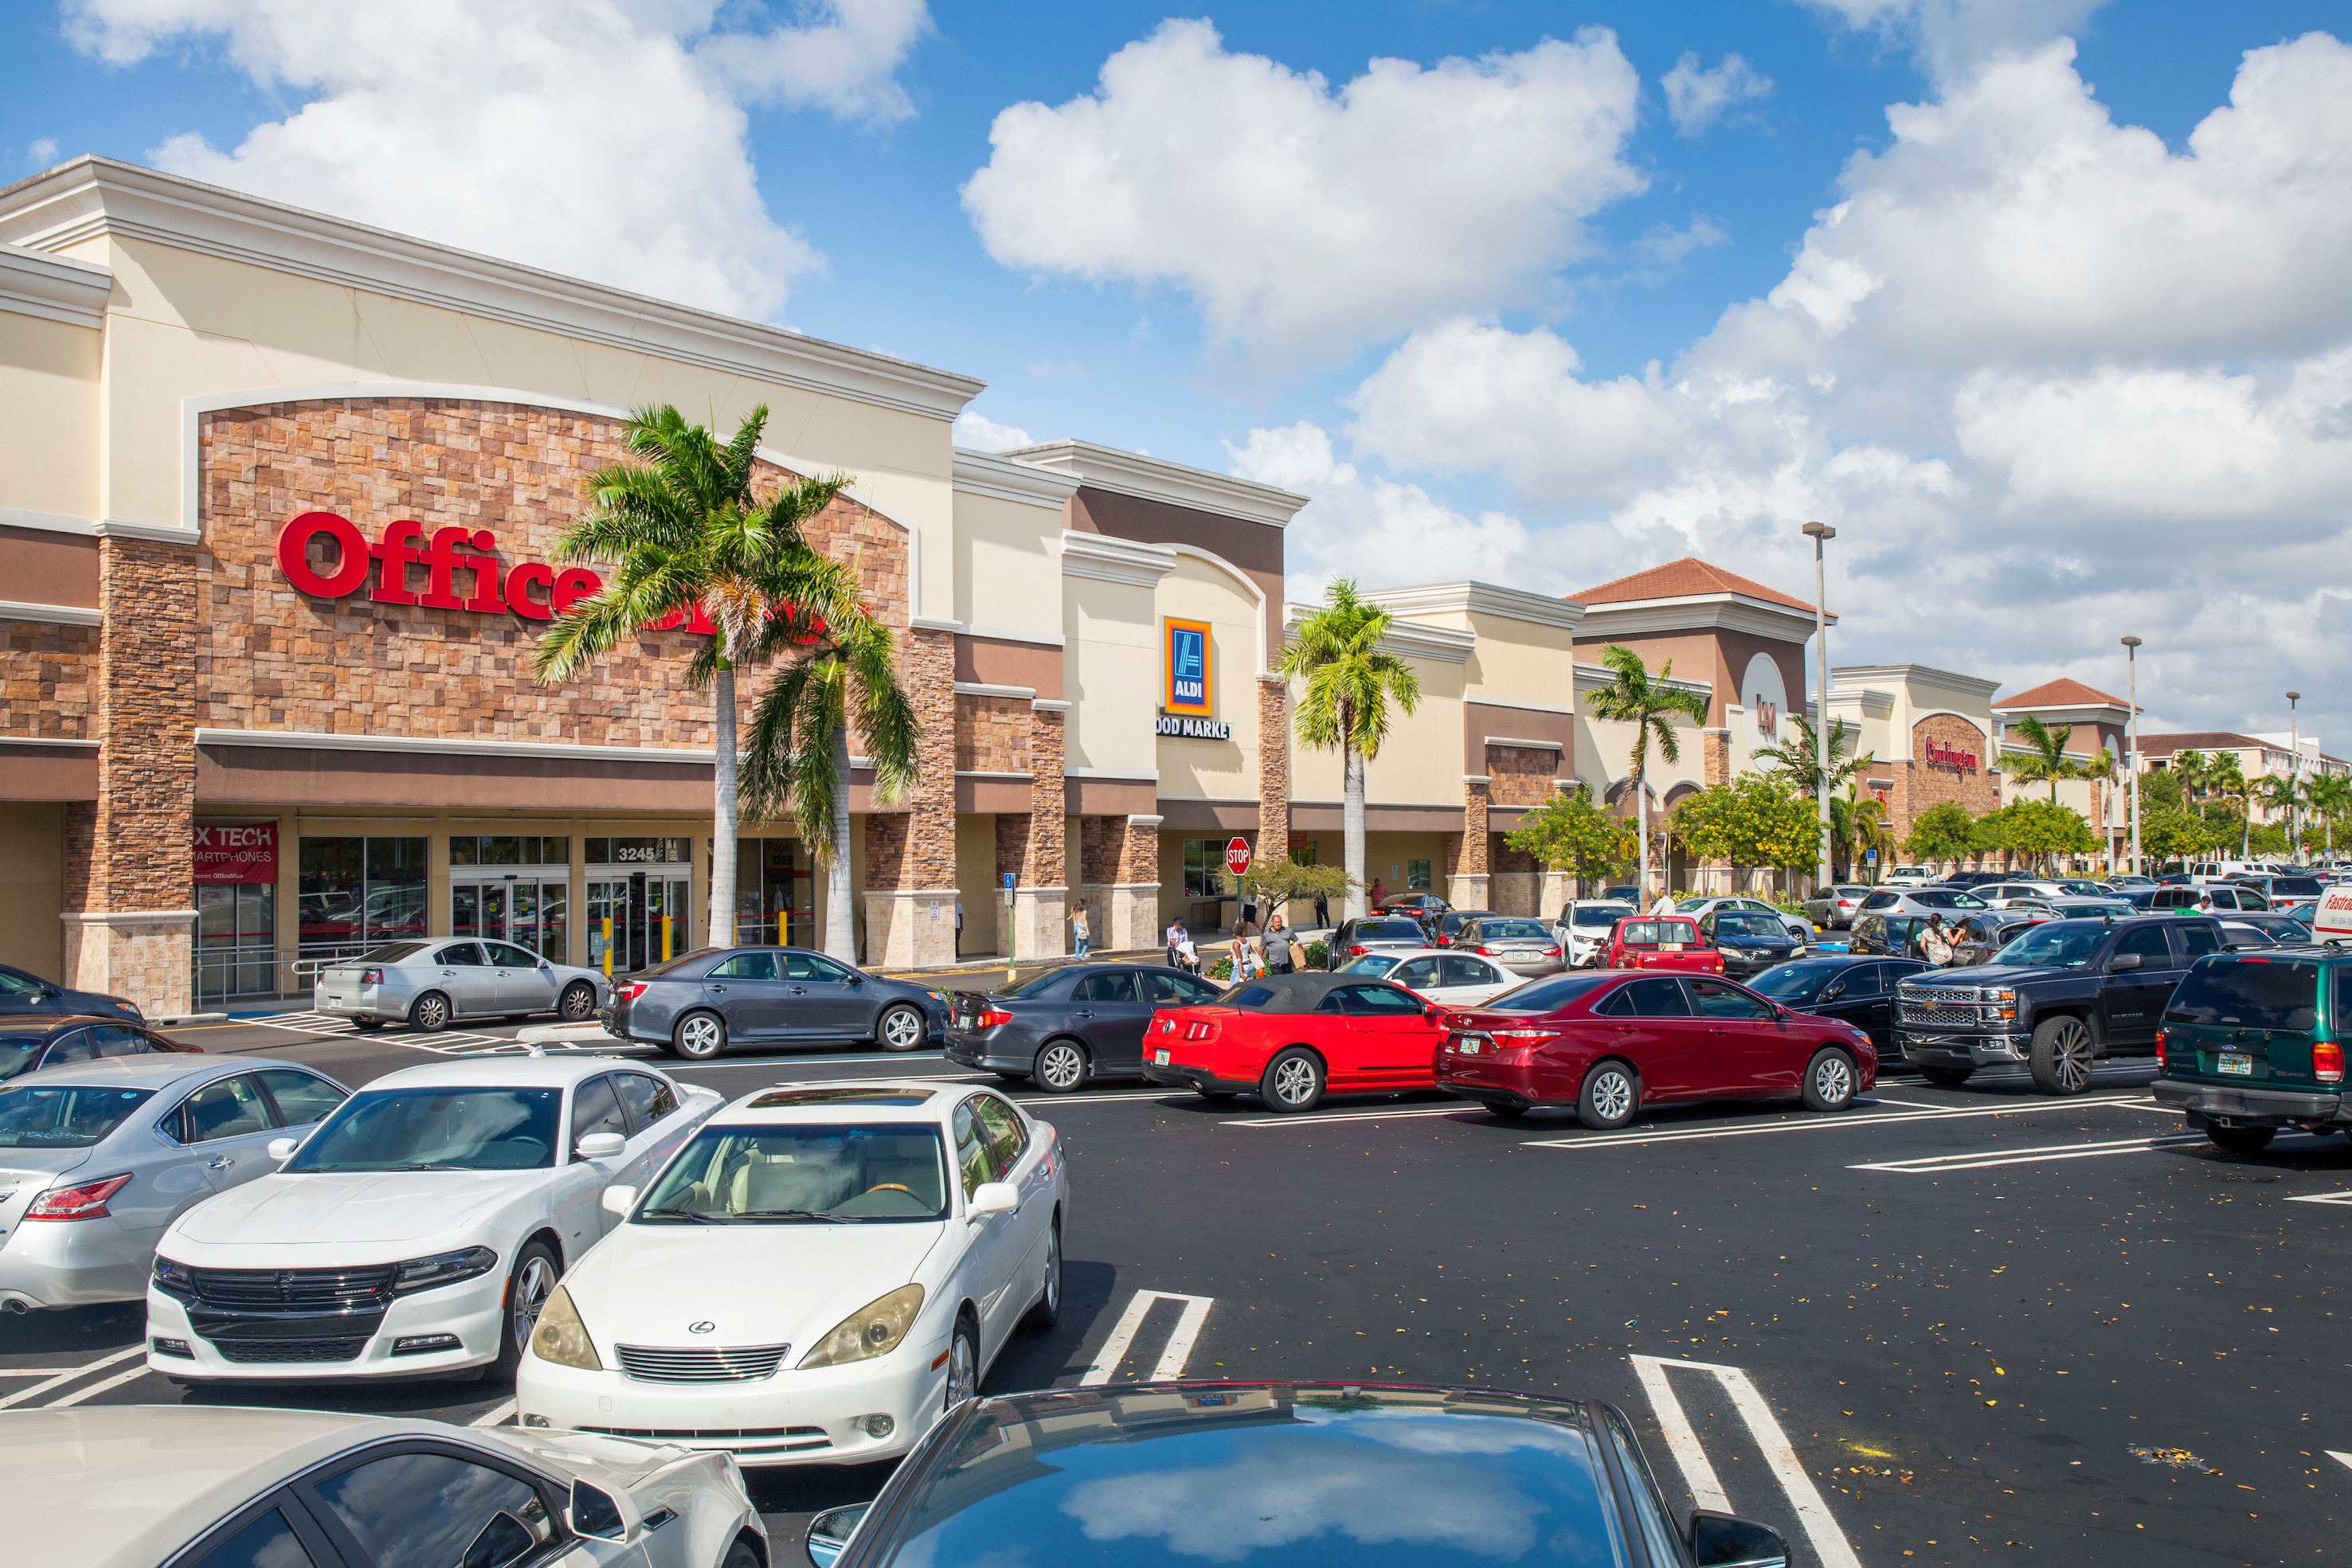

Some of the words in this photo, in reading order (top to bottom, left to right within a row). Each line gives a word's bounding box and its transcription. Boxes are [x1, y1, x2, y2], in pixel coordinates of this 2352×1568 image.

[276, 511, 604, 620] Office
[1175, 680, 1202, 698] ALDI
[1156, 717, 1180, 734] OOD
[1183, 719, 1235, 739] MARKET
[216, 827, 272, 847] TECH
[619, 847, 655, 861] 3245
[1228, 849, 1249, 864] STOP
